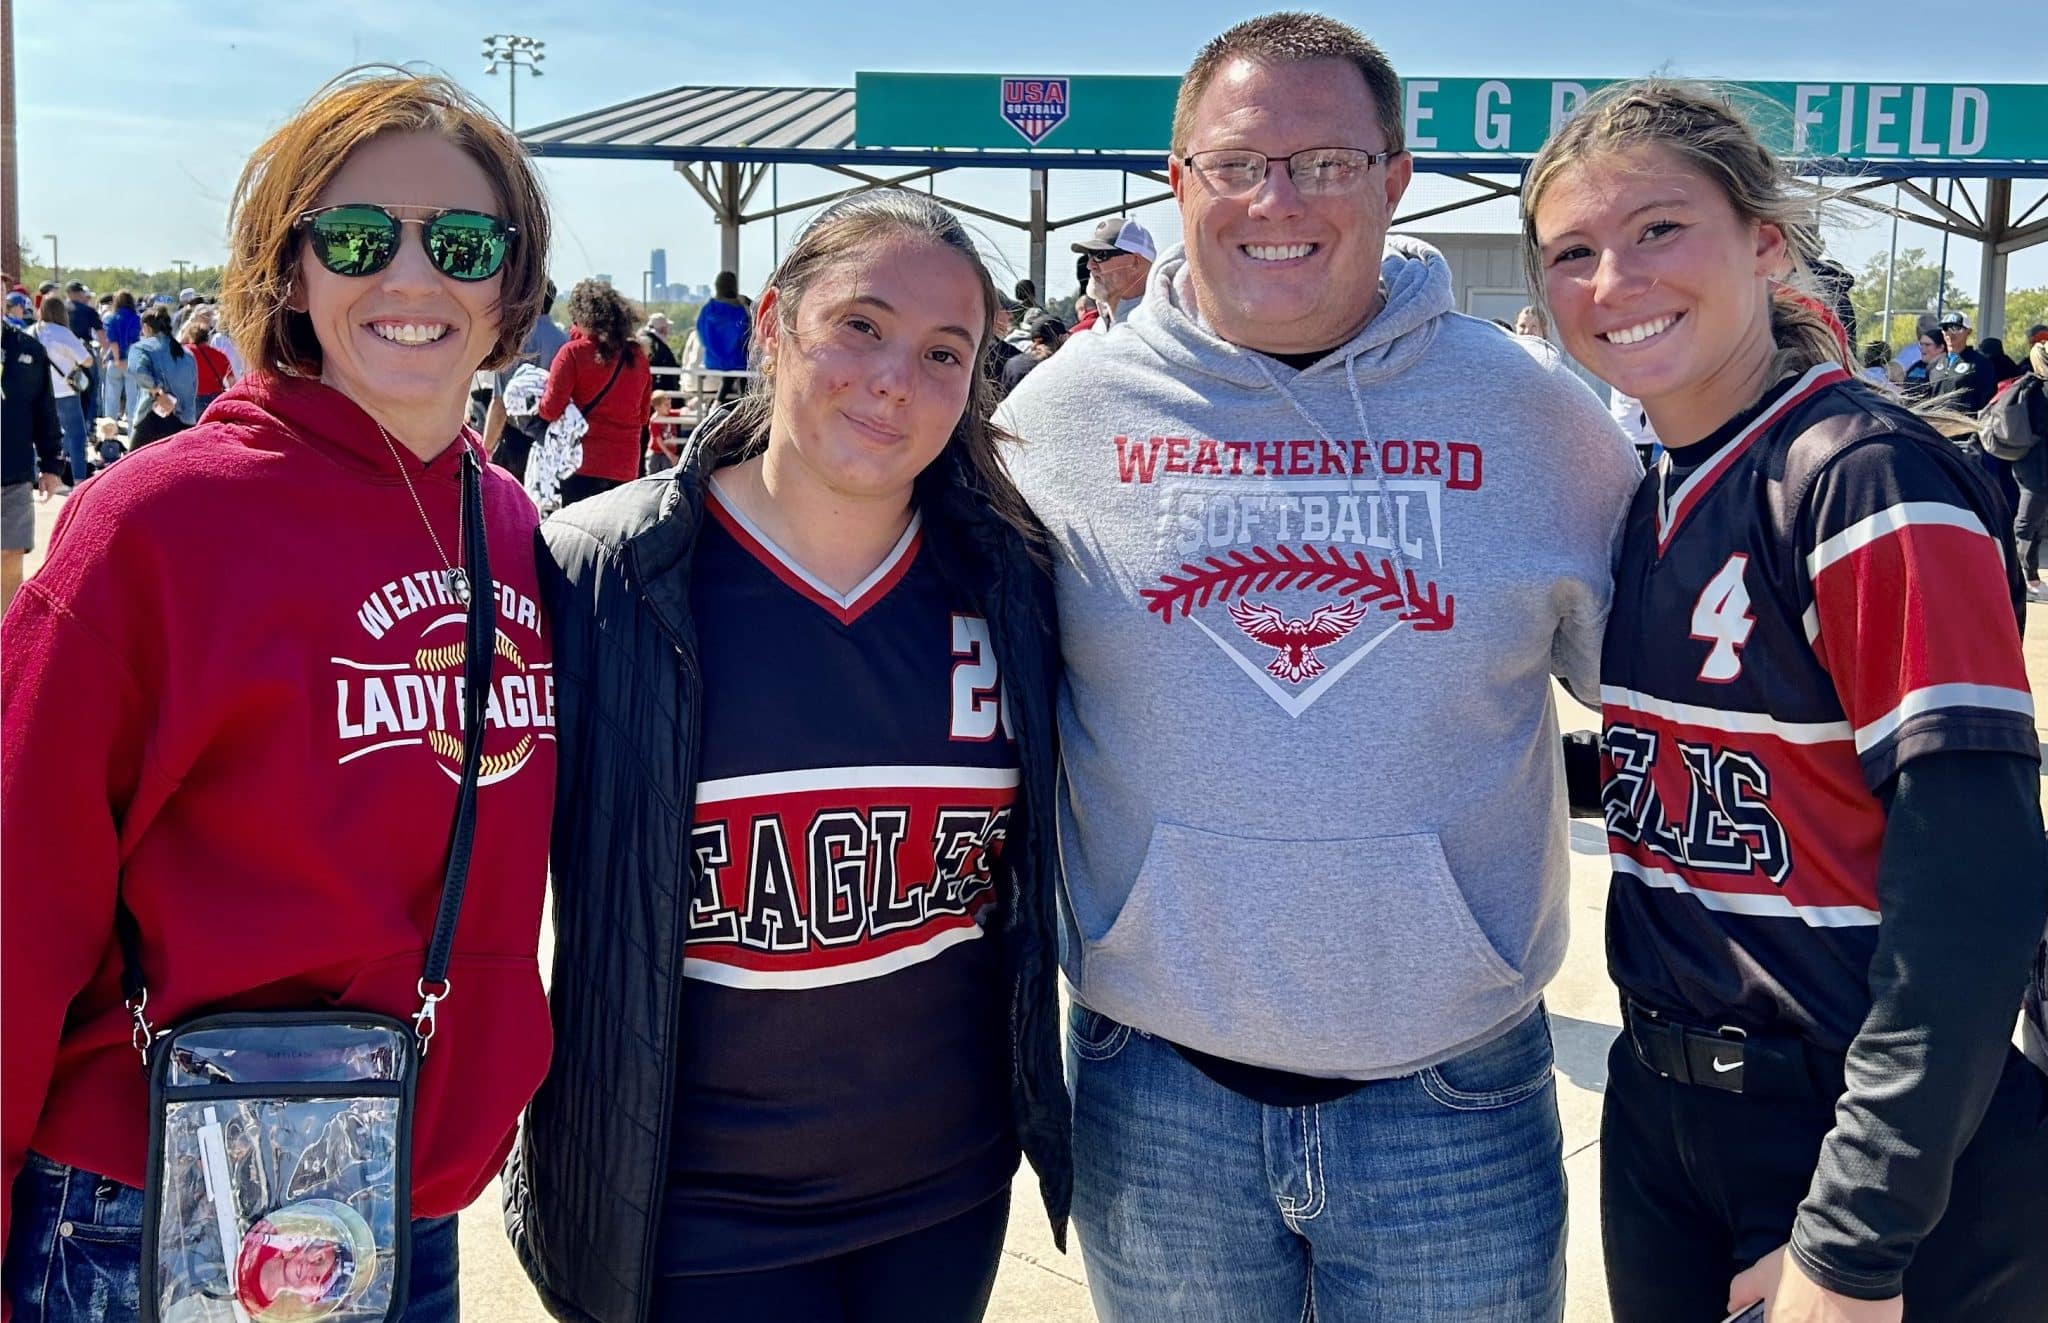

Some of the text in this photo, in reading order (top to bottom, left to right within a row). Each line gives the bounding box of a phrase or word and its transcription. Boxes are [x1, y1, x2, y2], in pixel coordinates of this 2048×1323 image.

[1005, 81, 1064, 104] USA
[1006, 104, 1063, 115] SOFTBALL
[1792, 84, 1990, 156] FIELD
[1113, 435, 1483, 491] WEATHERFORD
[1176, 494, 1423, 560] SOFTBALL
[1688, 551, 1757, 684] 4
[337, 675, 446, 739] LADY
[949, 611, 1016, 743] 2
